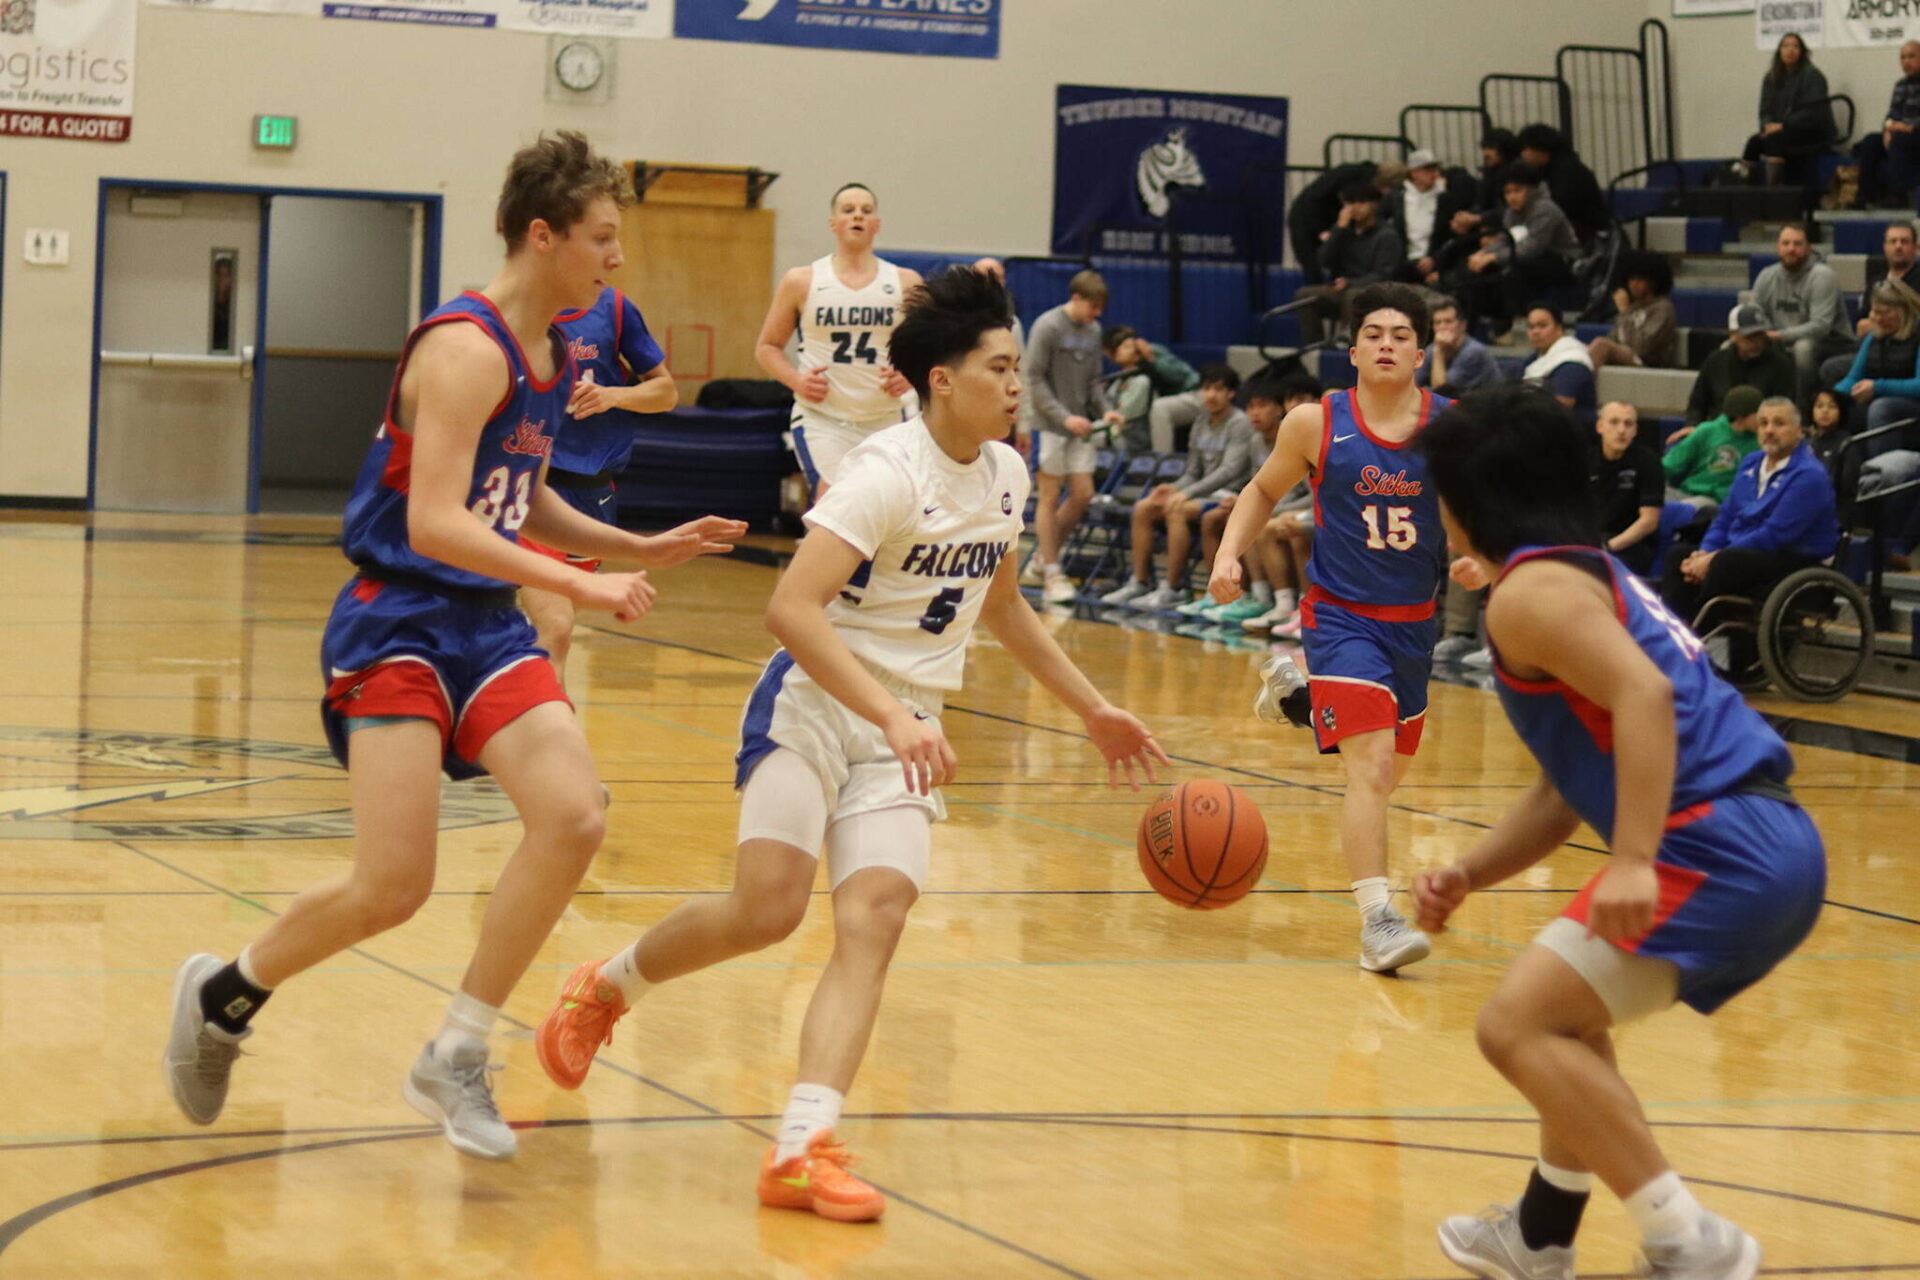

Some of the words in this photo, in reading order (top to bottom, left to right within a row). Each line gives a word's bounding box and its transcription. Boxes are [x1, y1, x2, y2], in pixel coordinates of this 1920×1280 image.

[795, 12, 842, 26] FLYING
[843, 15, 861, 27] AT
[31, 90, 74, 105] Freight
[77, 93, 123, 106] Transfer
[10, 114, 44, 134] FOR
[46, 117, 60, 135] A
[61, 118, 124, 138] QUOTE!
[815, 307, 894, 326] FALCONS
[830, 331, 877, 365] 24
[1354, 465, 1423, 497] Sitka
[1361, 504, 1417, 552] 15
[918, 587, 965, 635] 5
